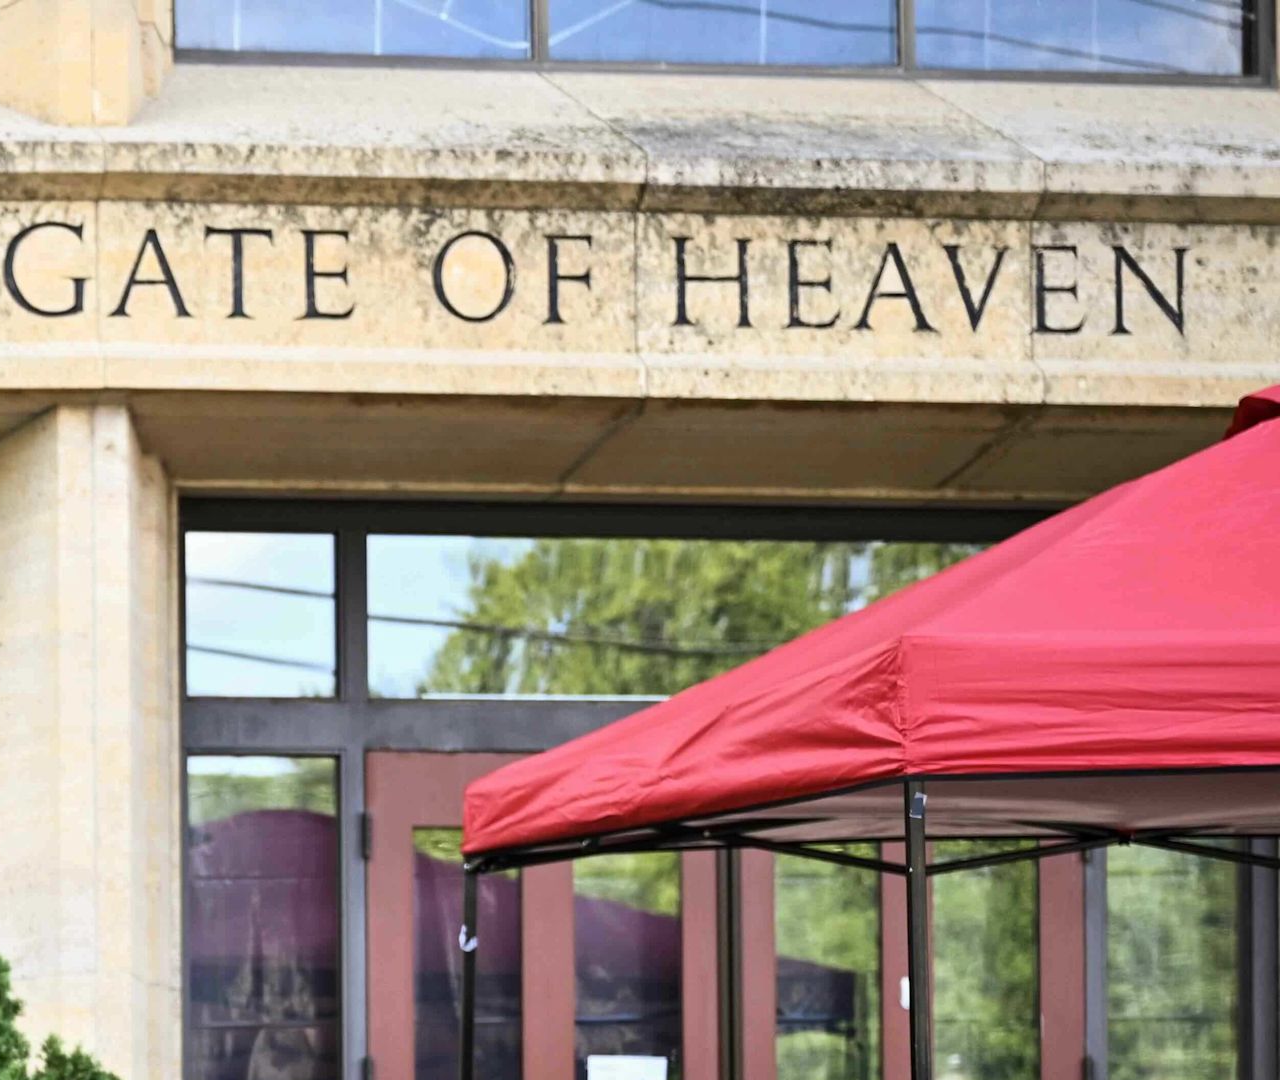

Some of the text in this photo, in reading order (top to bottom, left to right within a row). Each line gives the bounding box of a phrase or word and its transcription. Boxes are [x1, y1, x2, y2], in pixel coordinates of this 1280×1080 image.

[2, 221, 356, 320] GATE
[431, 230, 593, 326] OF
[671, 234, 1190, 335] HEAVEN
